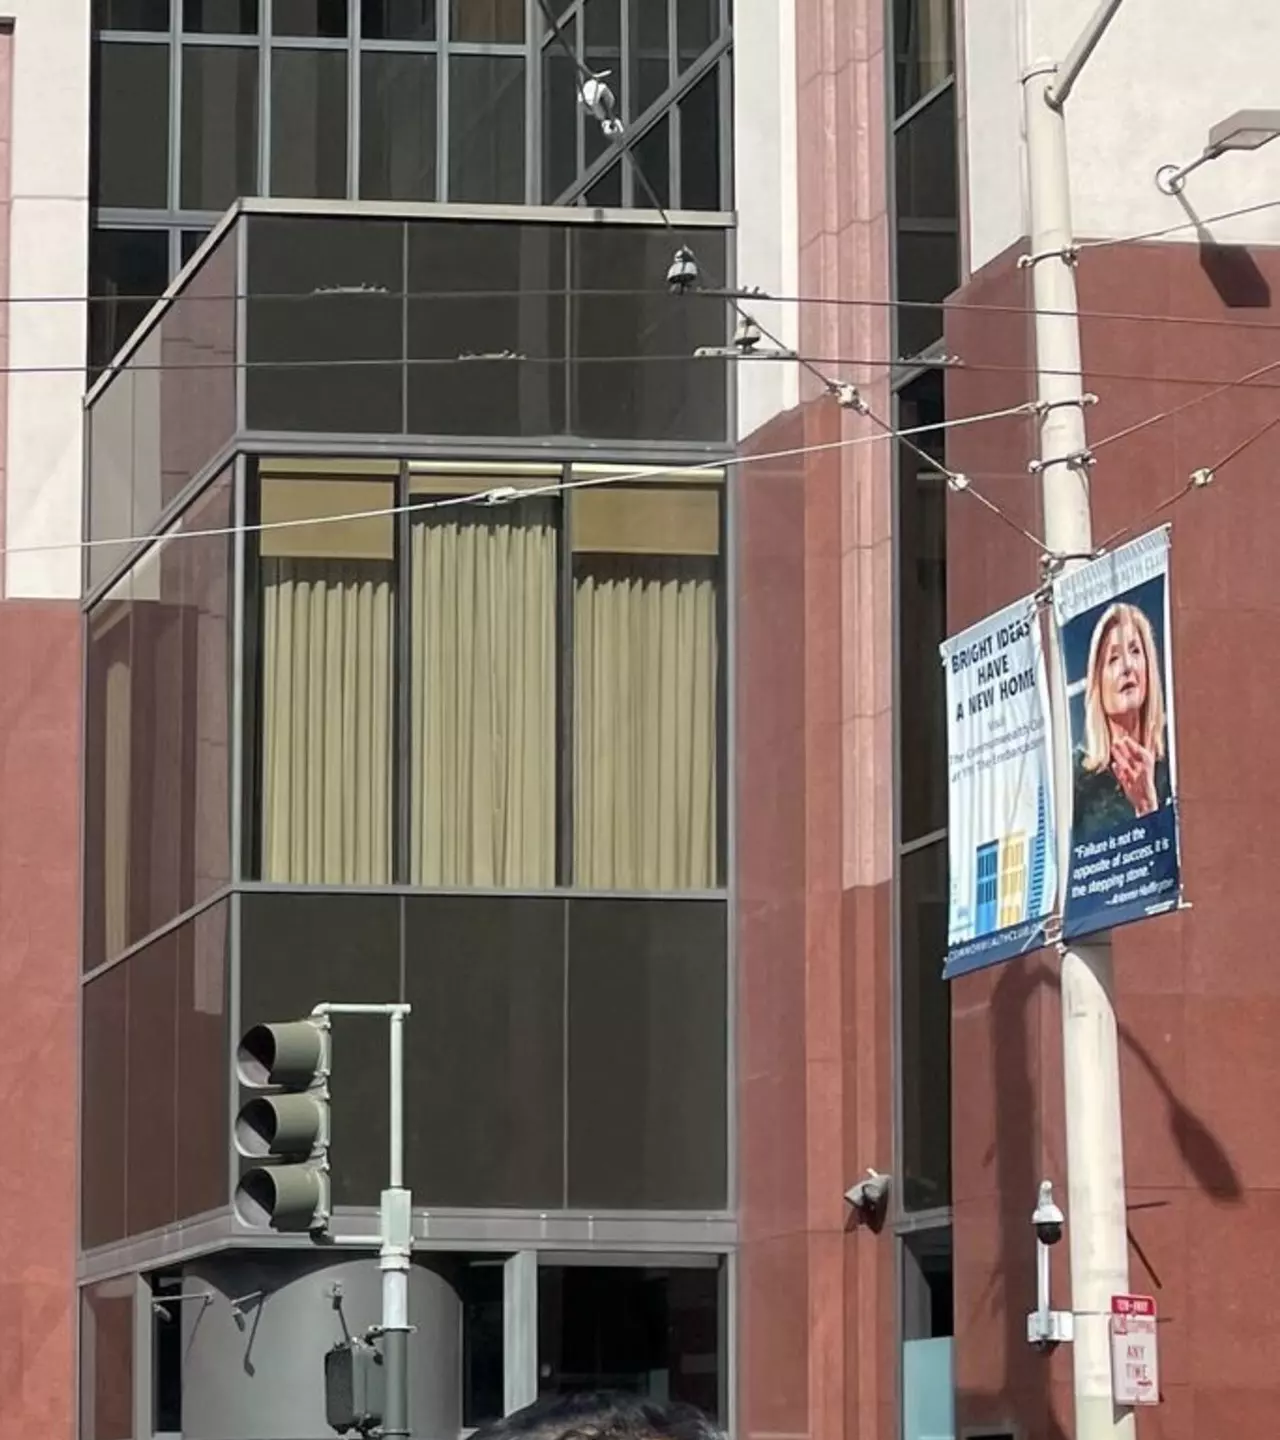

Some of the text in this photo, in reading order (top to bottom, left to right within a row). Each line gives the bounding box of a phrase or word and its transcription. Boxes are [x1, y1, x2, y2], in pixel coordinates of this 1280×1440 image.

[951, 635, 993, 674] BRIGHT
[977, 654, 1010, 686] HAVE
[956, 667, 1036, 722] A NEW HOME
[1127, 1345, 1146, 1360] ANY
[1125, 1363, 1148, 1380] TIME
